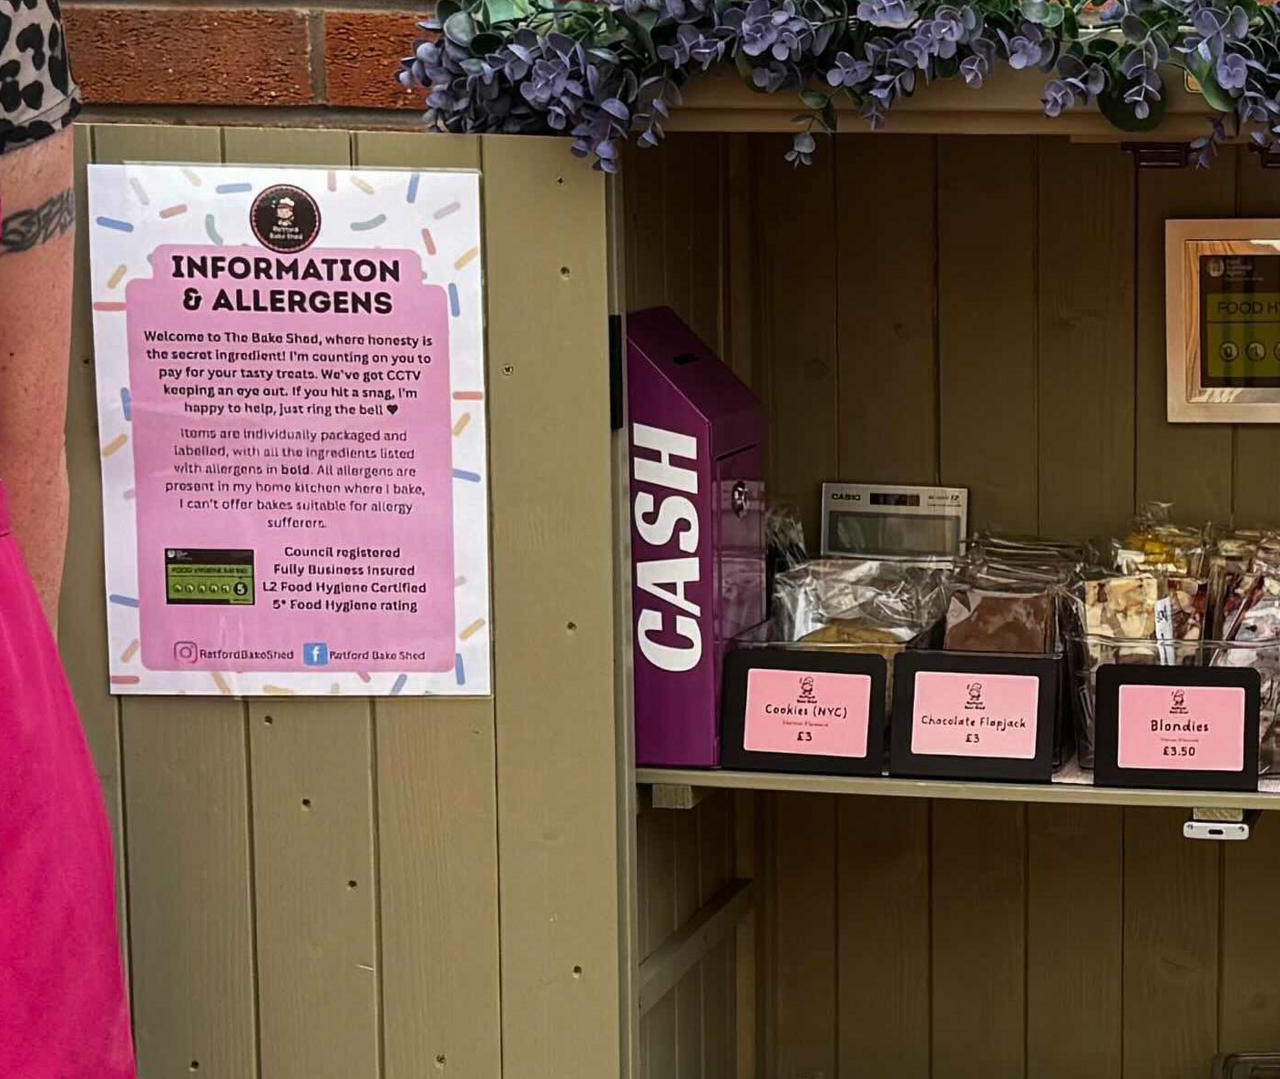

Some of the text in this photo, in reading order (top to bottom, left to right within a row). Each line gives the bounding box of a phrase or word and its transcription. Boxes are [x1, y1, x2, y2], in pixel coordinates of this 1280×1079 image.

[172, 256, 399, 282] INFORMATION
[183, 288, 392, 314] & ALLERGENS
[1217, 301, 1263, 315] FOOD
[143, 330, 205, 343] Welcome
[207, 332, 221, 343] to
[223, 331, 249, 343] The
[251, 332, 283, 344] Bake
[325, 333, 365, 345] where
[367, 334, 419, 349] honesty
[422, 335, 433, 347] is
[145, 347, 169, 360] the
[171, 350, 213, 361] secret
[289, 350, 309, 362] I'm
[311, 351, 369, 366] counting
[371, 354, 389, 363] on
[391, 355, 415, 367] you
[417, 354, 432, 365] to
[158, 368, 183, 381] pay
[185, 366, 205, 378] for
[207, 369, 238, 381] your
[240, 368, 274, 382] tasty
[362, 371, 384, 383] got
[386, 369, 421, 381] CCTV
[163, 383, 215, 399] keeping
[217, 387, 234, 396] an
[236, 387, 260, 399] eye
[292, 385, 302, 397] If
[303, 388, 328, 400] you
[331, 386, 349, 398] hit
[351, 389, 359, 398] a
[398, 387, 417, 399] I'm
[184, 401, 225, 416] happy
[227, 403, 242, 414] to
[279, 402, 304, 417] just
[306, 404, 333, 417] ring
[334, 404, 356, 416] the
[359, 403, 384, 416] bell
[219, 429, 241, 440] are
[243, 428, 317, 443] individually
[320, 429, 381, 444] packaged
[383, 431, 407, 442] and
[232, 447, 377, 461] with the ingredients
[173, 461, 202, 474] with
[205, 463, 263, 477] allergens
[316, 464, 333, 476] All
[336, 465, 394, 479] allergens
[396, 467, 417, 477] are
[165, 481, 215, 493] present
[232, 483, 253, 495] my
[255, 481, 292, 493] home
[294, 481, 341, 494] kitchen
[343, 483, 383, 495] where
[221, 498, 253, 510] offer
[256, 499, 293, 511] bakes
[296, 499, 346, 511] suitable
[349, 500, 368, 512] for
[371, 501, 413, 515] allergy
[284, 546, 401, 561] Council registered
[633, 422, 702, 672] CASH
[273, 563, 415, 577] Fully Business Insured
[280, 581, 313, 593] Food
[315, 581, 368, 595] Hygiene
[370, 582, 427, 594] Certified
[289, 599, 322, 610] Food
[325, 599, 377, 613] Hygiene
[380, 599, 418, 614] rating
[765, 703, 848, 719] Cookies (NYC)
[921, 715, 1026, 732] Chocolate Flapjack
[1150, 718, 1209, 733] Blondies
[796, 731, 813, 742] £3
[965, 733, 980, 744] £3
[1162, 745, 1196, 757] £3.50
